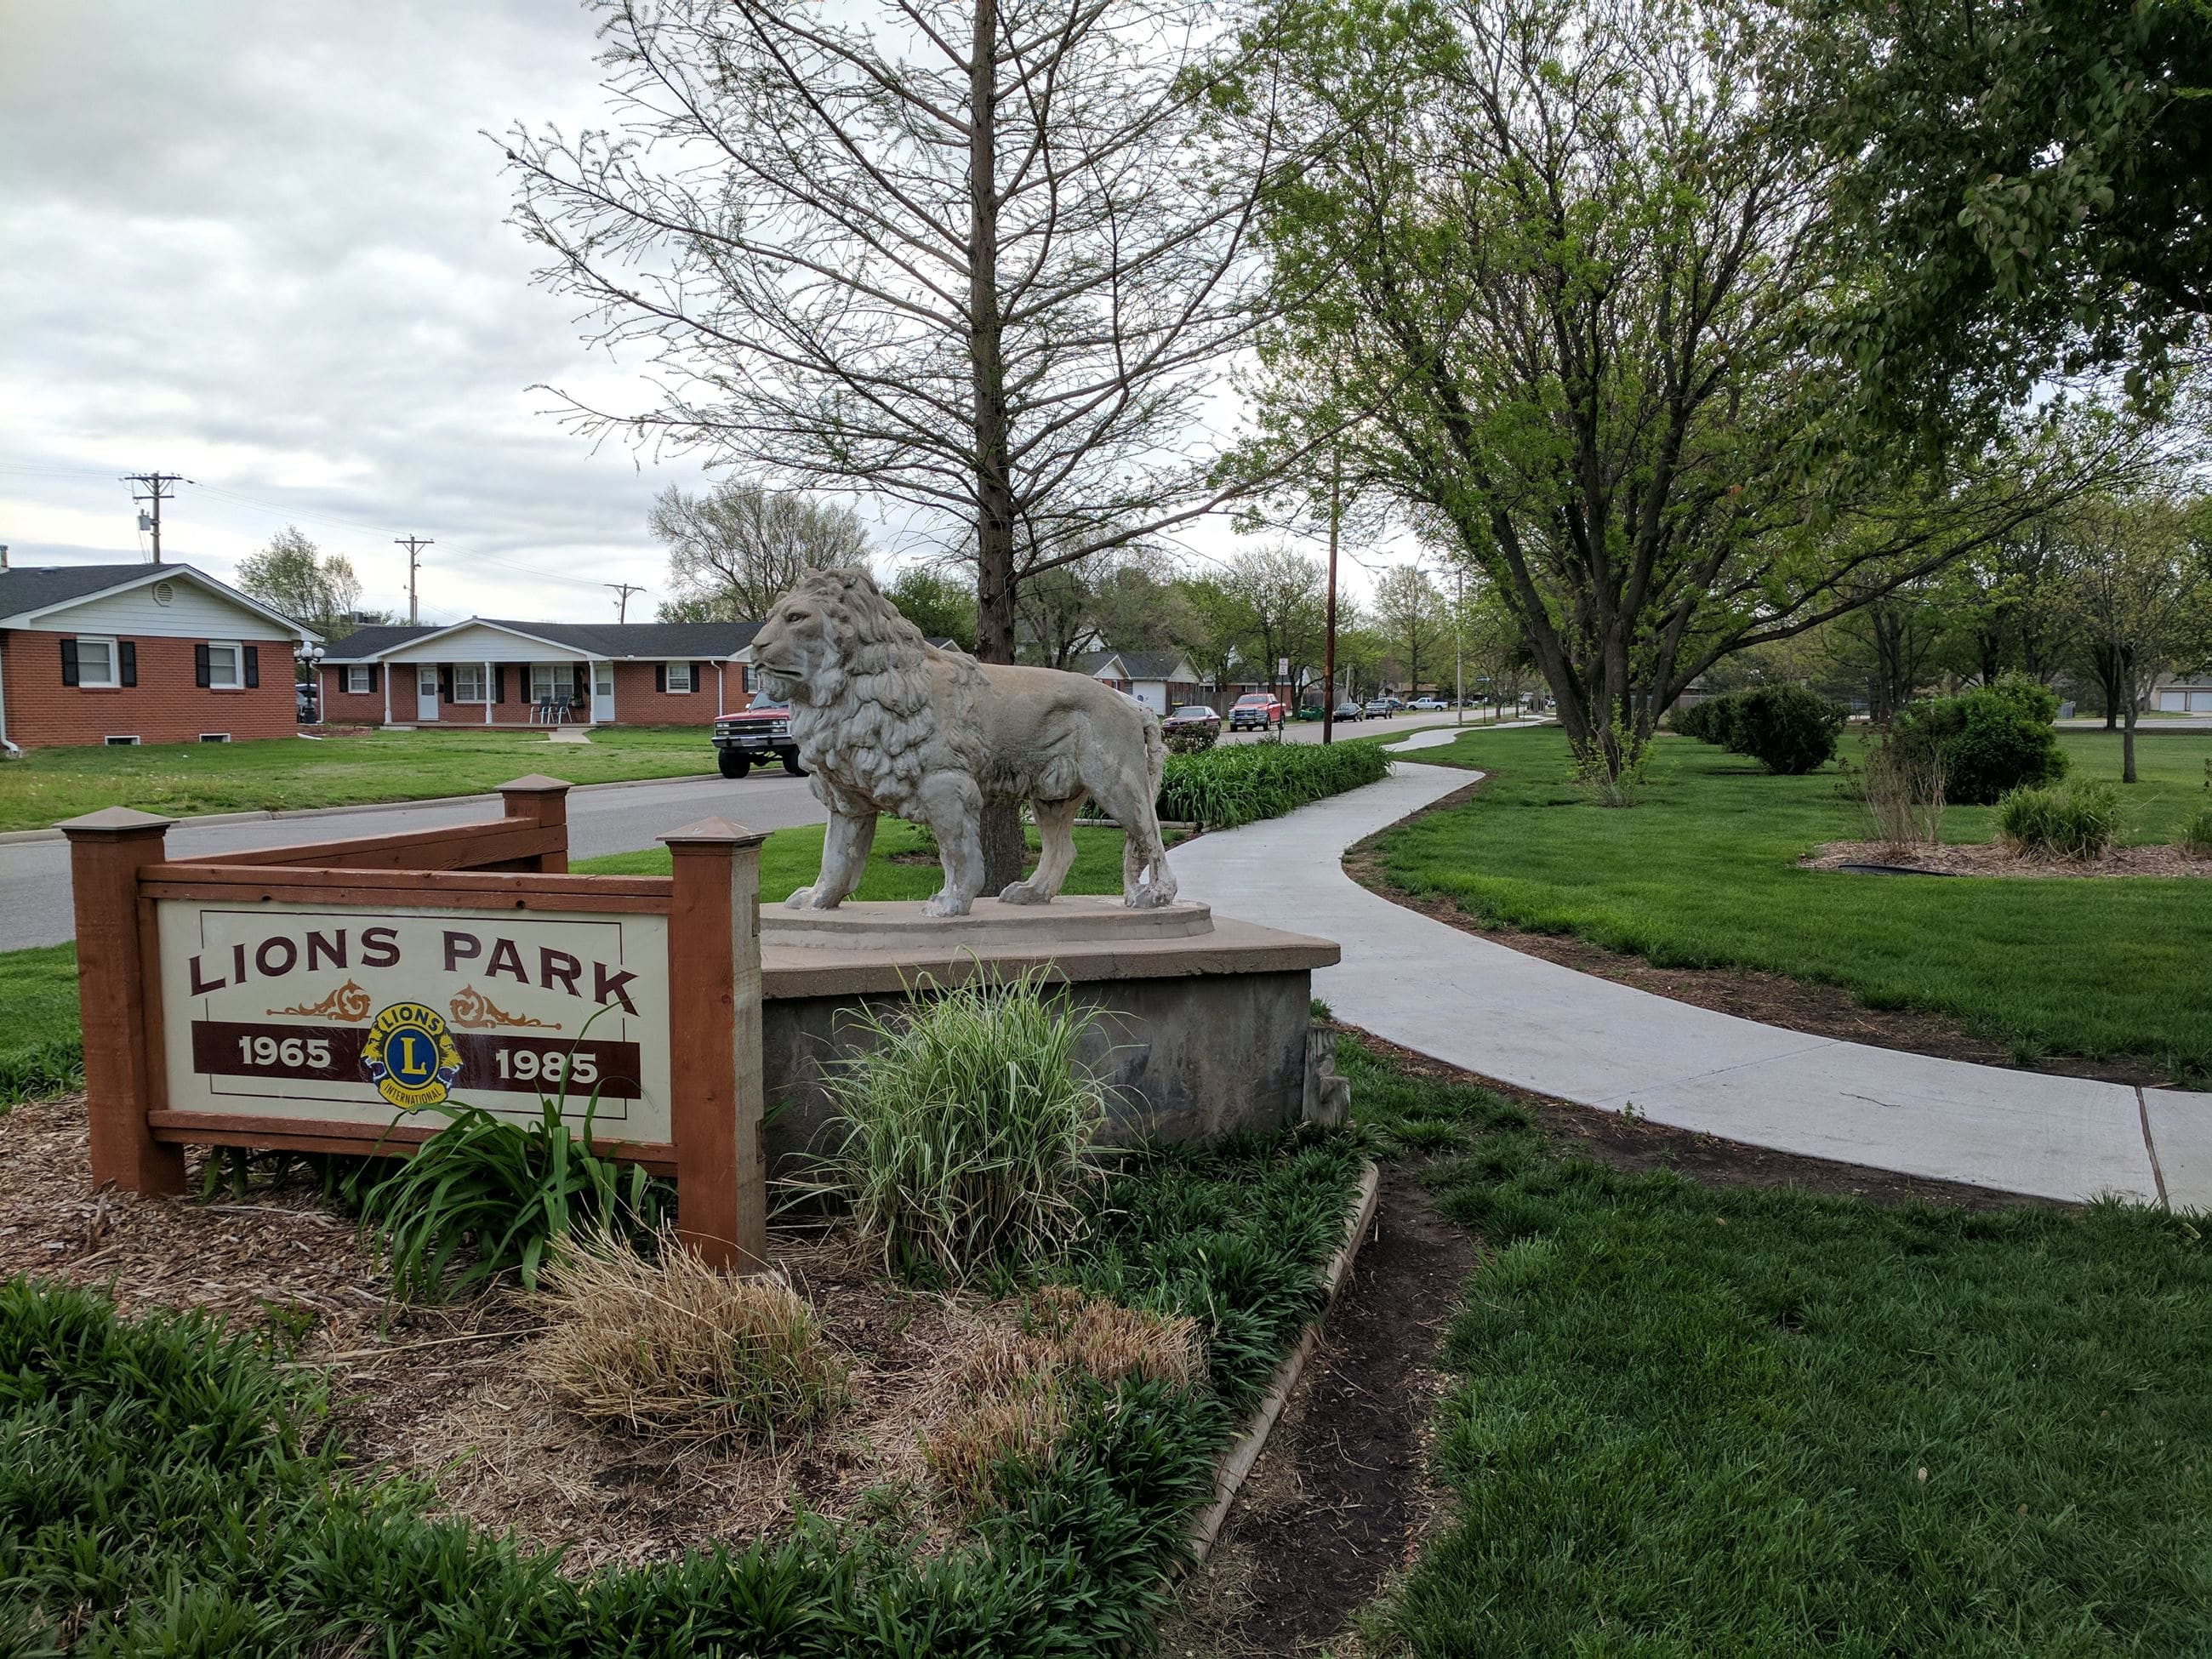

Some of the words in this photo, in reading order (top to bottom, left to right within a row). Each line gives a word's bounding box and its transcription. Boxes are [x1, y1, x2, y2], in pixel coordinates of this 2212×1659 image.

[188, 927, 400, 996] LIONS
[442, 931, 640, 1017] PARK
[381, 1006, 440, 1031] LIONS
[238, 1036, 331, 1068] 1965
[401, 1037, 426, 1075] L
[496, 1049, 598, 1083] 1985
[384, 1083, 442, 1105] INTERNATIONAL
